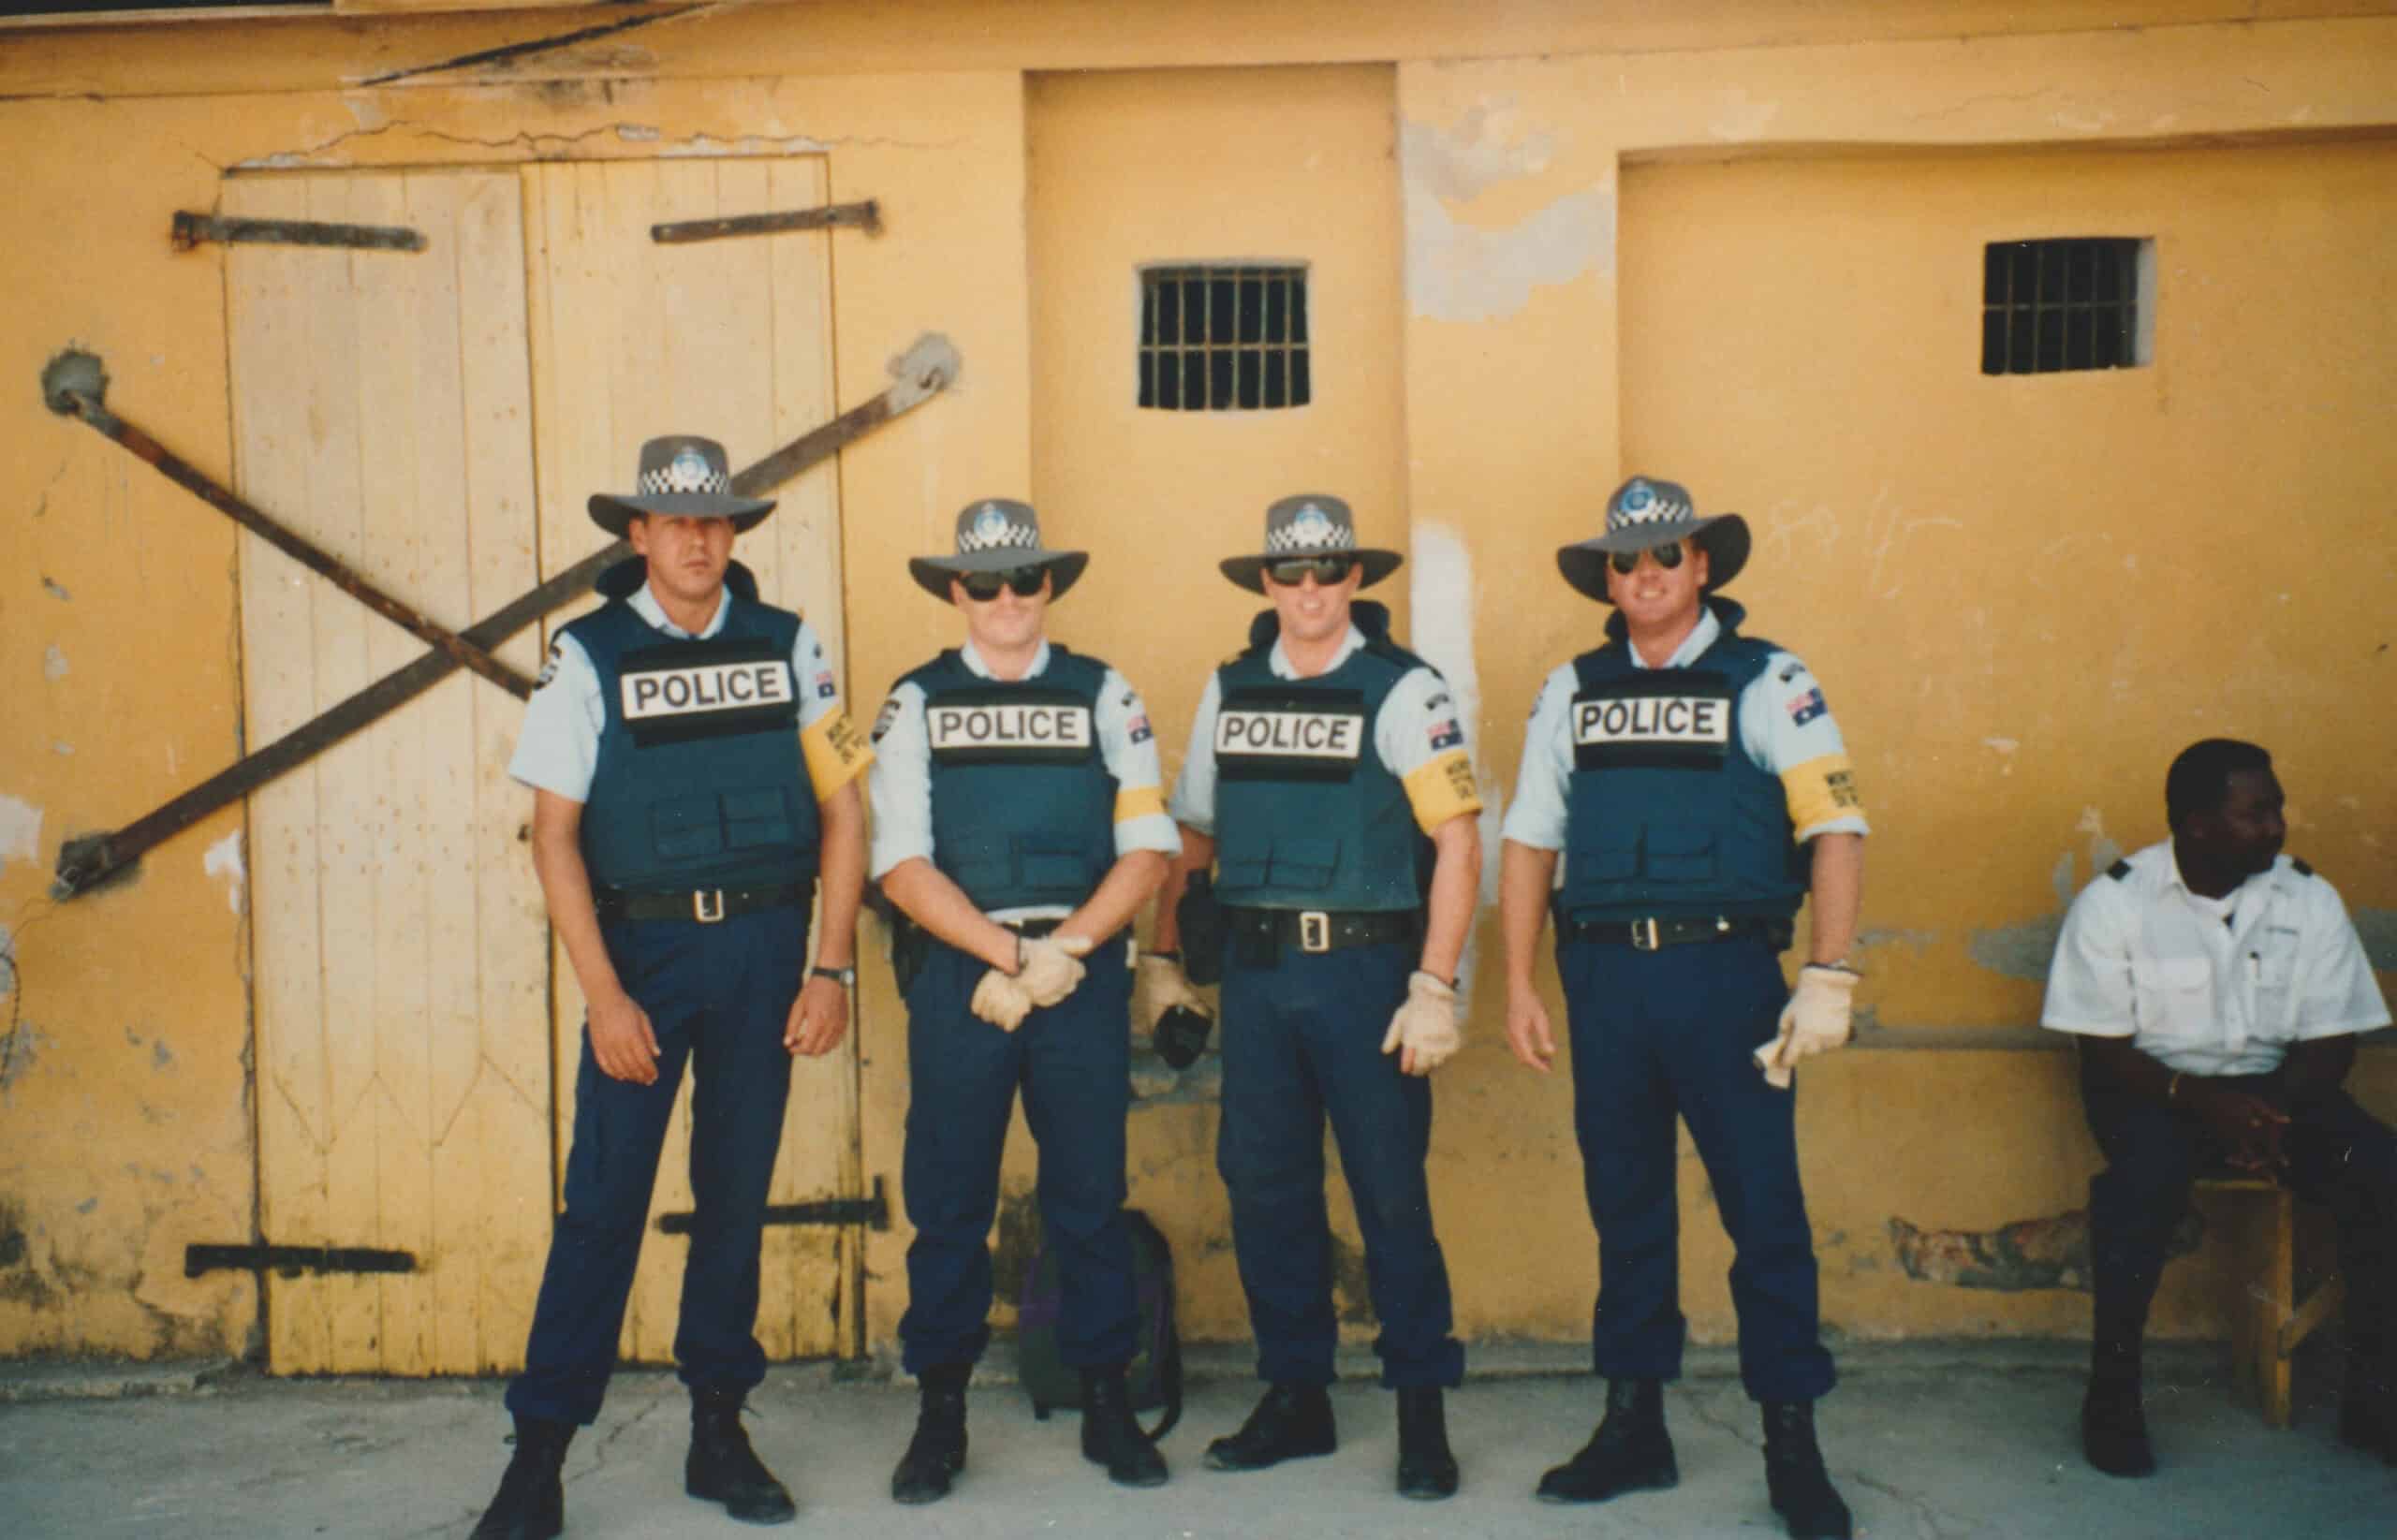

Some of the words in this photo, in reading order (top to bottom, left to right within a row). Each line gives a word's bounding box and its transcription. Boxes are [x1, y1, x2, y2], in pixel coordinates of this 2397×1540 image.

[634, 667, 780, 711] POLICE
[940, 711, 1078, 742] POLICE
[1223, 716, 1349, 749] POLICE
[1580, 701, 1716, 738] POLICE
